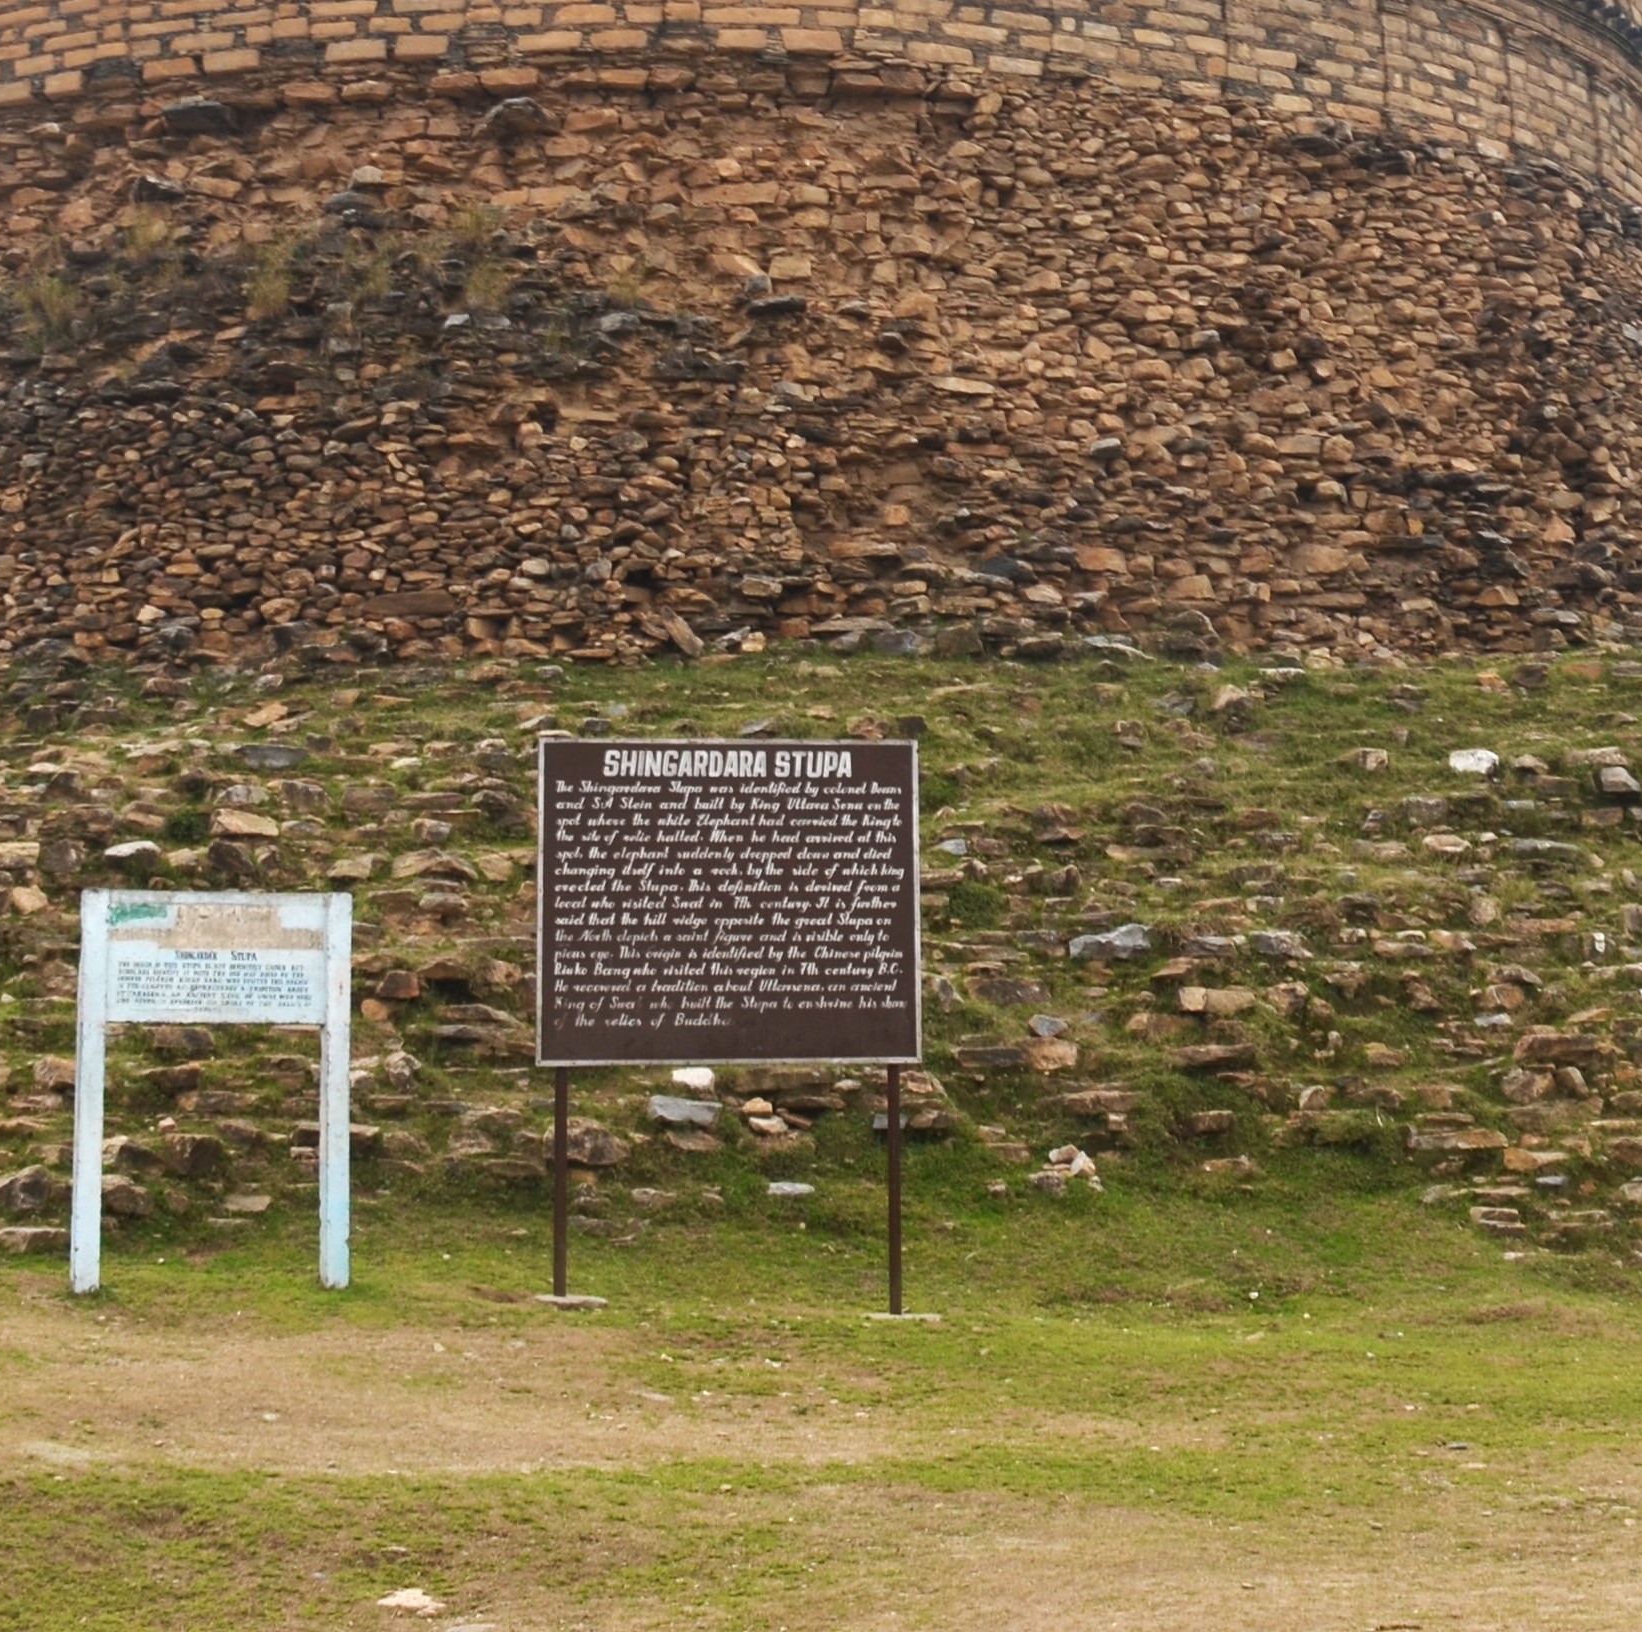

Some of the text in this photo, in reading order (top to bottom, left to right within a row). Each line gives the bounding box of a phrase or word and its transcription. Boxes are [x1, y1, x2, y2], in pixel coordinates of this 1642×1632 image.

[603, 750, 852, 778] SHINGARDARA STUPA
[556, 780, 574, 793] The
[669, 780, 703, 797] Stupa
[709, 785, 734, 793] was
[740, 782, 800, 797] identified
[804, 782, 819, 798] by
[824, 782, 865, 794] colonel
[555, 797, 585, 809] and
[620, 797, 652, 809] Stein
[659, 797, 687, 809] and
[694, 797, 725, 809] built
[730, 798, 746, 812] by
[751, 798, 780, 813] King
[832, 799, 863, 810] Sena
[883, 799, 900, 810] the
[556, 813, 581, 829] spot
[588, 813, 626, 826] where
[633, 813, 651, 826] the
[658, 814, 690, 826] white
[758, 814, 786, 826] had
[790, 815, 838, 827] carried
[841, 814, 858, 826] the
[892, 815, 903, 826] to
[556, 829, 574, 842] the
[581, 830, 601, 842] site
[604, 830, 619, 846] of
[709, 830, 743, 843] When
[751, 830, 765, 843] he
[772, 830, 800, 843] had
[806, 831, 853, 843] arrived
[858, 831, 870, 842] at
[876, 831, 897, 843] this
[589, 846, 607, 859] the
[613, 846, 669, 862] elephant
[677, 846, 735, 862] suddenly
[740, 847, 792, 864] dropped
[797, 847, 829, 860] down
[833, 848, 860, 860] and
[864, 848, 892, 860] died
[555, 863, 615, 878] changing
[622, 862, 655, 878] itself
[659, 862, 685, 875] into
[747, 863, 762, 878] by
[765, 862, 783, 876] the
[793, 864, 819, 876] side
[825, 863, 839, 878] of
[843, 863, 878, 876] which
[555, 880, 606, 892] erected
[612, 880, 632, 892] the
[689, 879, 711, 892] This
[718, 880, 782, 896] definition
[789, 881, 799, 892] is
[805, 880, 852, 892] derived
[855, 880, 888, 896] from
[555, 896, 587, 909] local
[591, 897, 615, 909] who
[622, 896, 667, 909] visited
[672, 896, 704, 909] Swat
[709, 899, 723, 909] in
[816, 897, 830, 909] It
[836, 898, 846, 909] is
[850, 896, 897, 913] further
[555, 913, 585, 925] said
[589, 913, 615, 925] that
[621, 912, 638, 925] the
[644, 913, 667, 925] hill
[673, 913, 708, 928] ridge
[714, 913, 764, 929] opposite
[772, 913, 790, 925] the
[795, 913, 833, 929] great
[837, 913, 873, 928] Stupa
[555, 929, 574, 941] the
[578, 929, 612, 942] North
[617, 930, 658, 946] depicts
[676, 930, 708, 942] saint
[712, 930, 753, 946] figure
[759, 929, 787, 942] and
[793, 931, 802, 942] is
[806, 930, 844, 942] visible
[849, 930, 875, 946] only
[878, 929, 890, 942] to
[554, 949, 586, 962] pious
[620, 945, 641, 959] This
[689, 949, 697, 959] is
[703, 947, 765, 961] identified
[769, 947, 783, 961] by
[787, 947, 807, 959] the
[814, 947, 861, 959] Chinese
[863, 946, 904, 963] pilgrim
[633, 963, 657, 976] who
[664, 963, 706, 976] visited
[711, 962, 733, 975] this
[737, 965, 776, 978] region
[782, 965, 795, 975] in
[825, 963, 874, 978] century
[554, 980, 569, 992] He
[651, 979, 708, 992] tradition
[714, 980, 753, 992] about
[851, 980, 897, 991] ancient
[589, 996, 605, 1011] of
[681, 996, 712, 1009] built
[716, 996, 734, 1009] the
[741, 996, 778, 1013] Stupa
[783, 996, 794, 1009] to
[858, 996, 877, 1009] his
[575, 1013, 595, 1027] the
[651, 1013, 665, 1030] of
